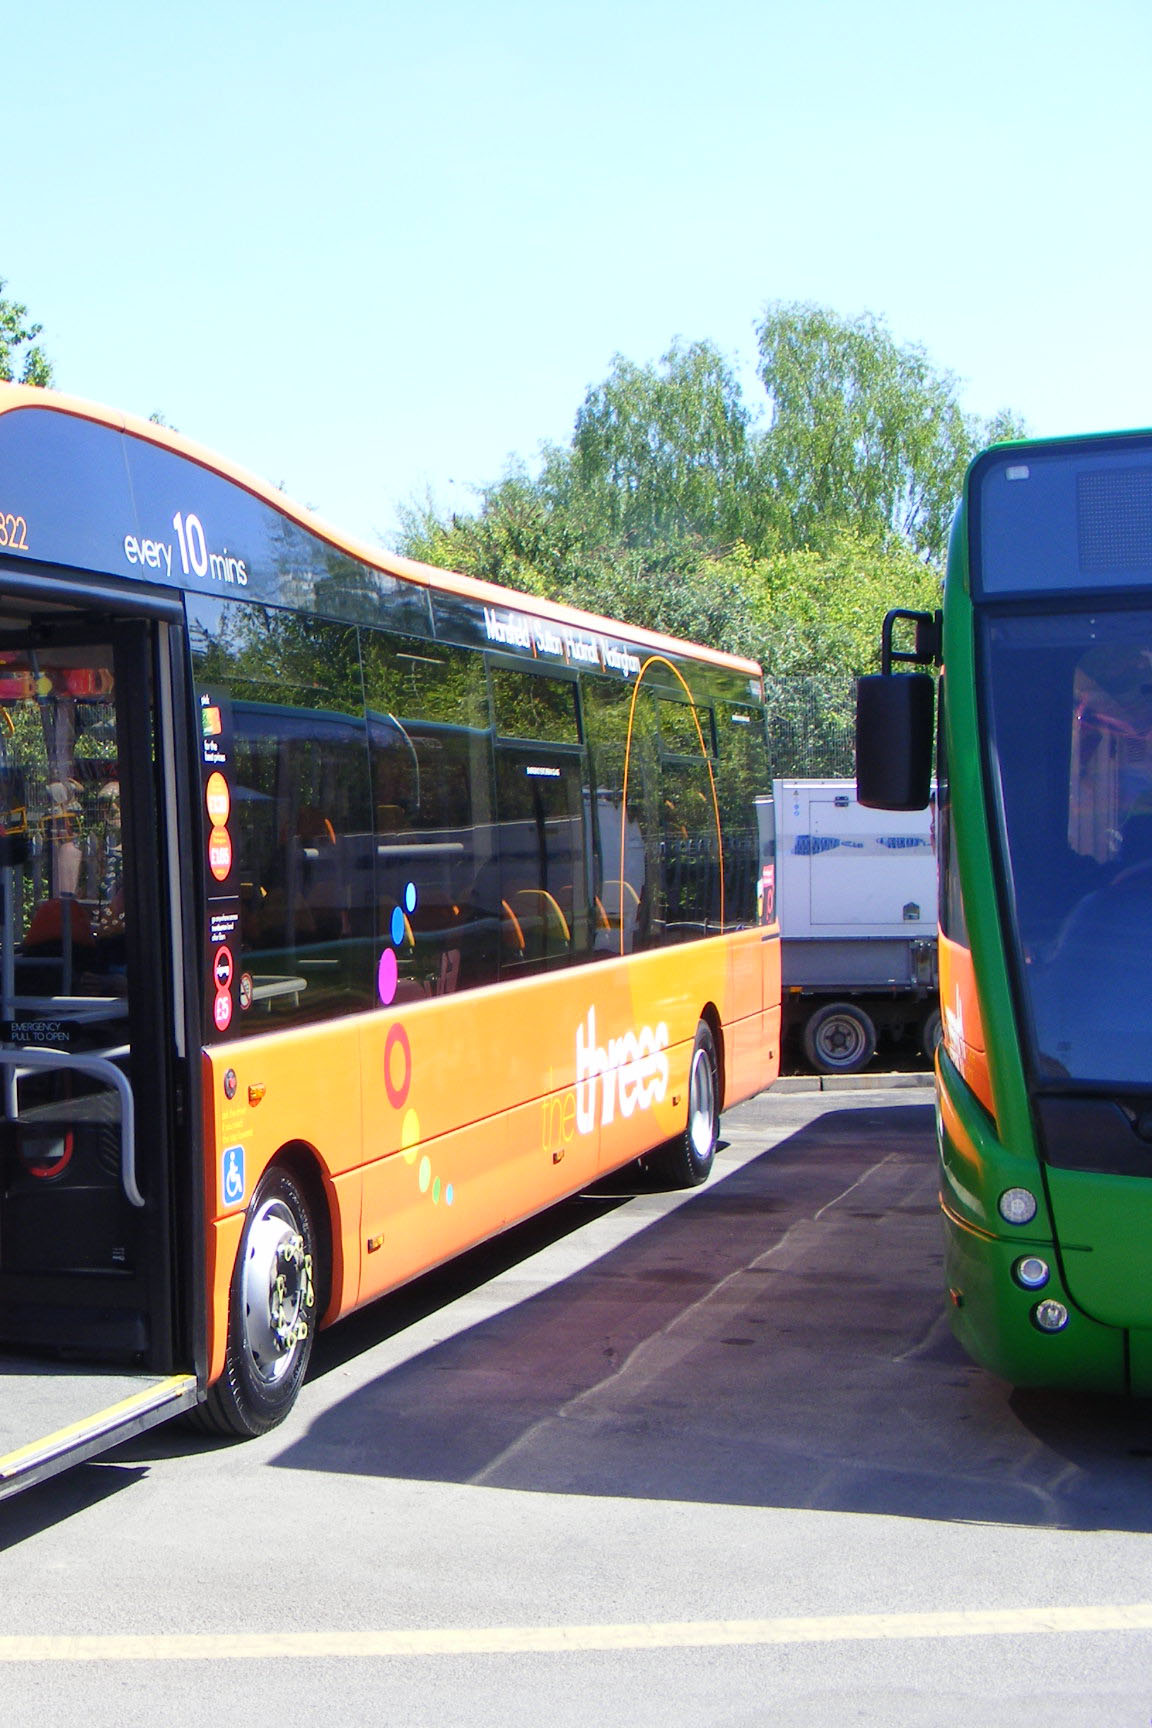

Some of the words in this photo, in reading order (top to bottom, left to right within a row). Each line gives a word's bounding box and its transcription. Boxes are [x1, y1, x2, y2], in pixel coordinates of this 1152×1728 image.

[124, 535, 172, 577] every
[173, 512, 208, 577] 10
[209, 548, 248, 586] mins
[11, 1022, 61, 1032] EMERGENCY
[11, 1031, 31, 1041] PULL
[33, 1032, 45, 1041] TO
[45, 1031, 70, 1042] OPEN
[541, 1065, 576, 1152] the
[575, 1003, 670, 1135] threes
